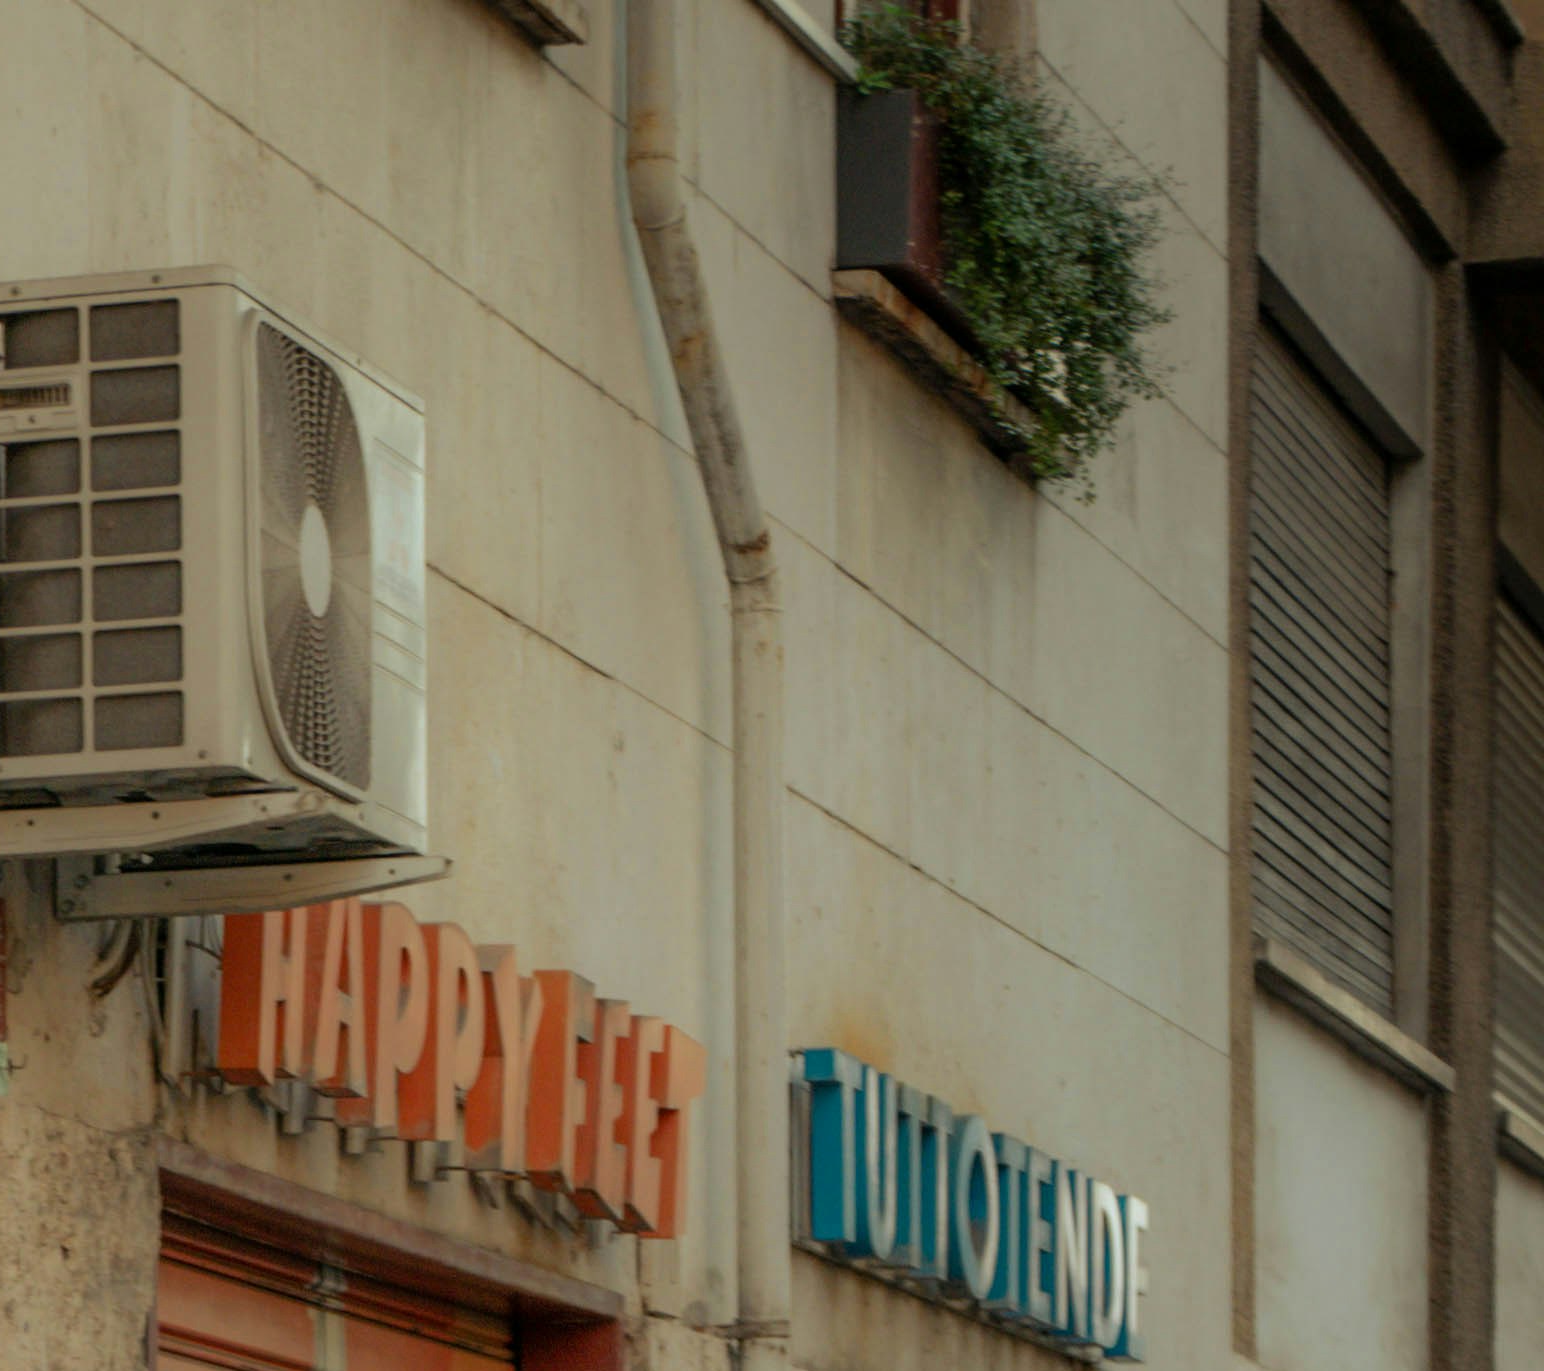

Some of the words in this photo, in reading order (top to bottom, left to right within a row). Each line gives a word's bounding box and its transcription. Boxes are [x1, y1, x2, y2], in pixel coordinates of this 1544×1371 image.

[219, 898, 543, 1172] HAPPY
[525, 970, 708, 1239] FEET
[804, 1047, 1149, 1362] TUTTOTENDE
